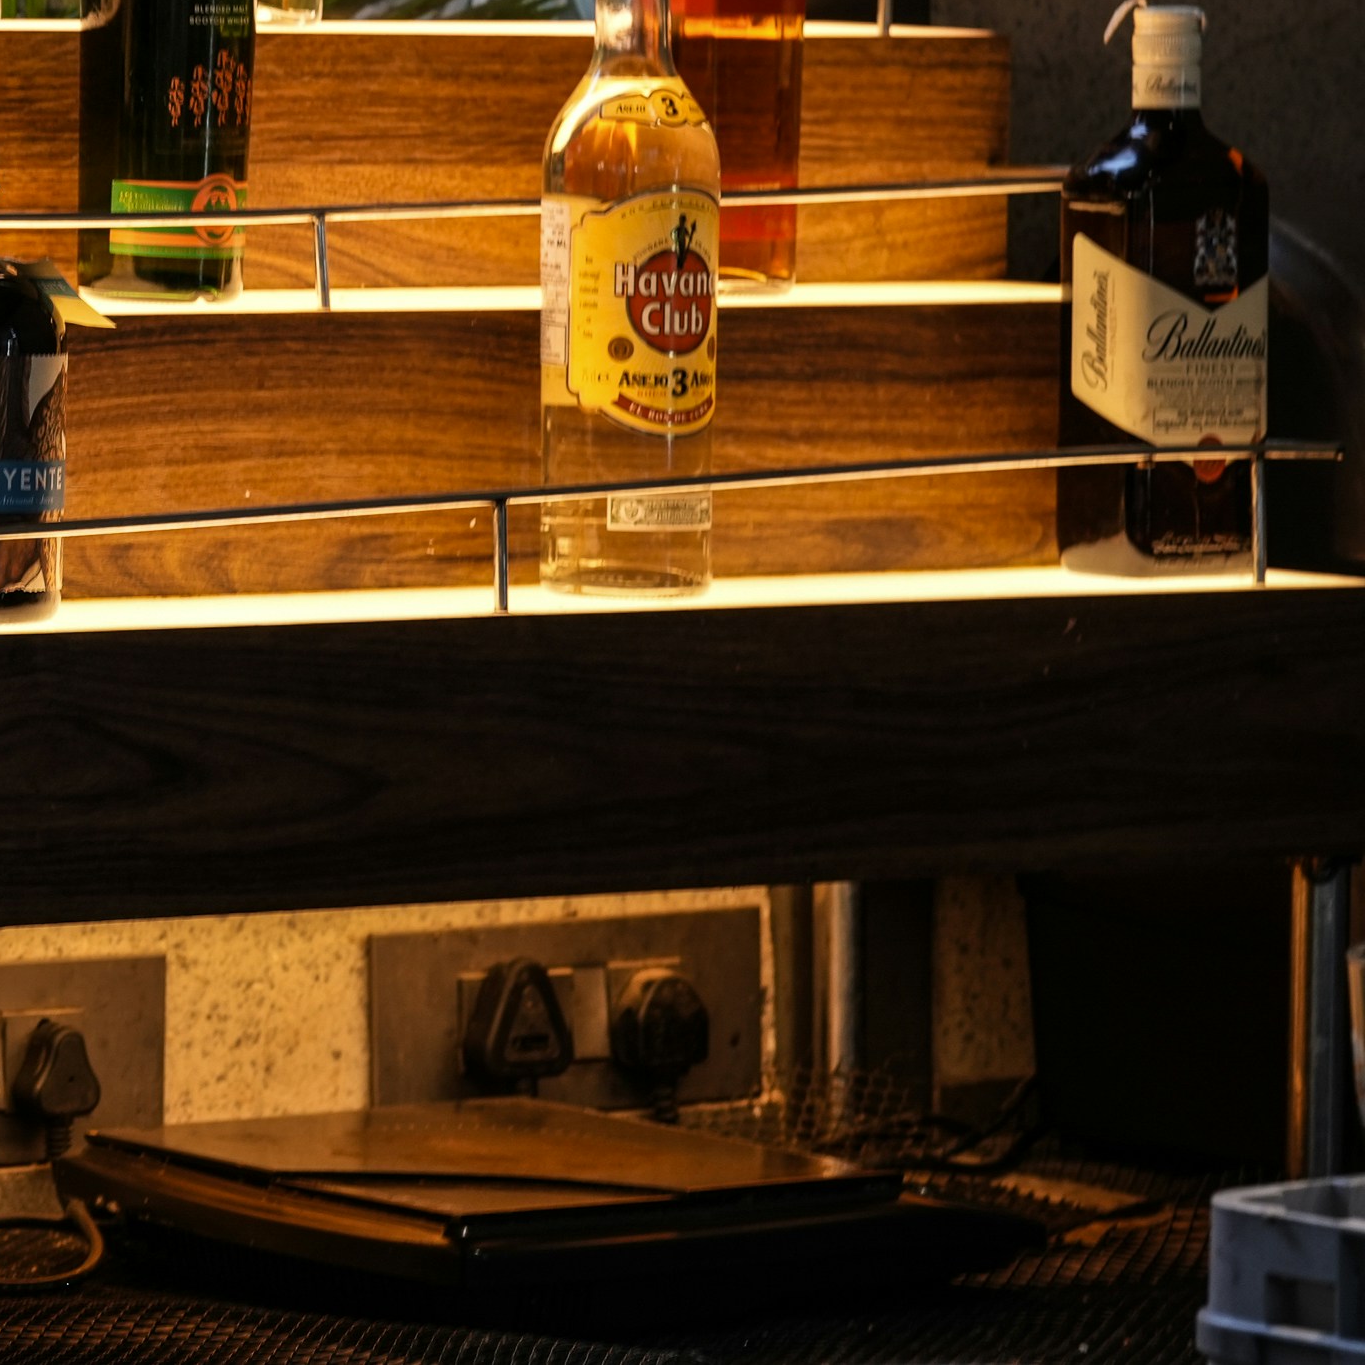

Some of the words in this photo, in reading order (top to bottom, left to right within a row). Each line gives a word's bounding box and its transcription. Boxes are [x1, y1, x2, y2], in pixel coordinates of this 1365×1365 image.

[194, 4, 231, 14] BLENDED
[189, 16, 225, 26] SCOTCH
[660, 97, 679, 117] 3
[641, 300, 704, 336] Club
[1185, 362, 1236, 375] FINEST
[671, 367, 689, 397] 3
[629, 401, 644, 414] EL
[647, 410, 671, 423] RON
